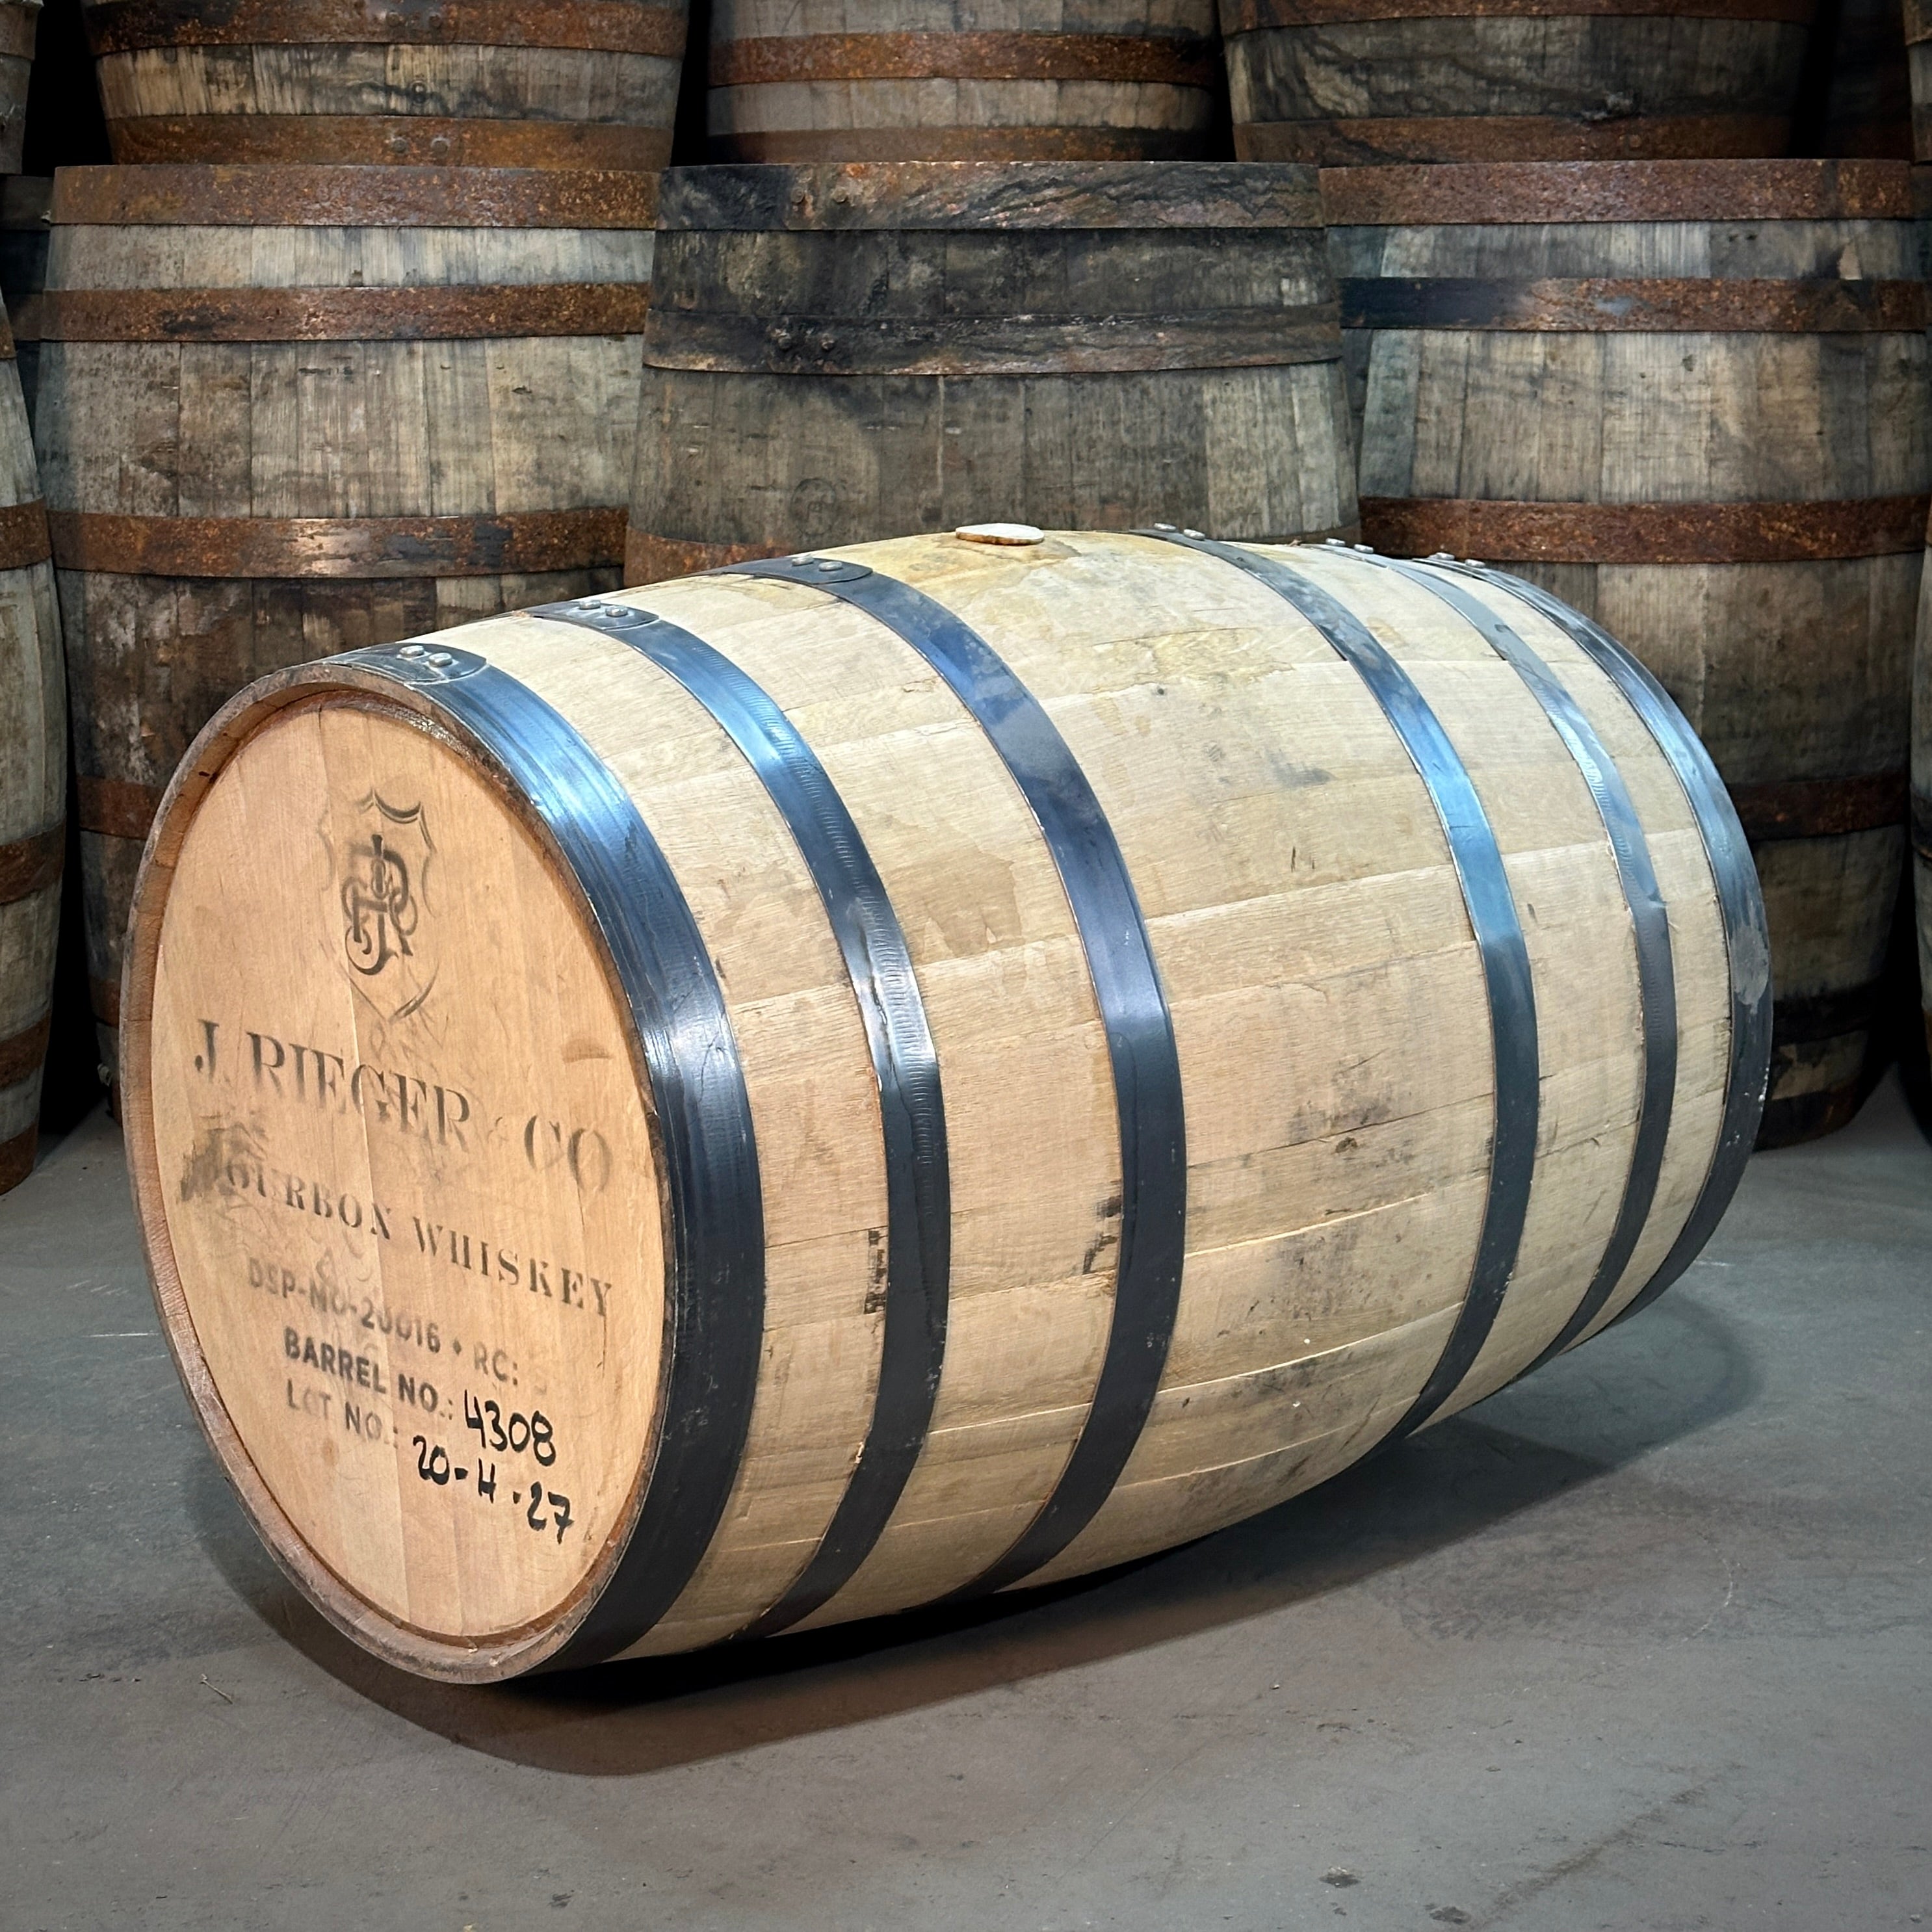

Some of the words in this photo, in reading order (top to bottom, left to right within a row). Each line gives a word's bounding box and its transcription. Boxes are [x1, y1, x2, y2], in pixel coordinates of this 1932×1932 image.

[245, 1030, 470, 1155] RIEGER
[412, 1216, 612, 1317] WHISKEY
[283, 1325, 387, 1394] BARREL
[473, 1339, 518, 1388] RC:
[463, 1389, 557, 1467] 4308
